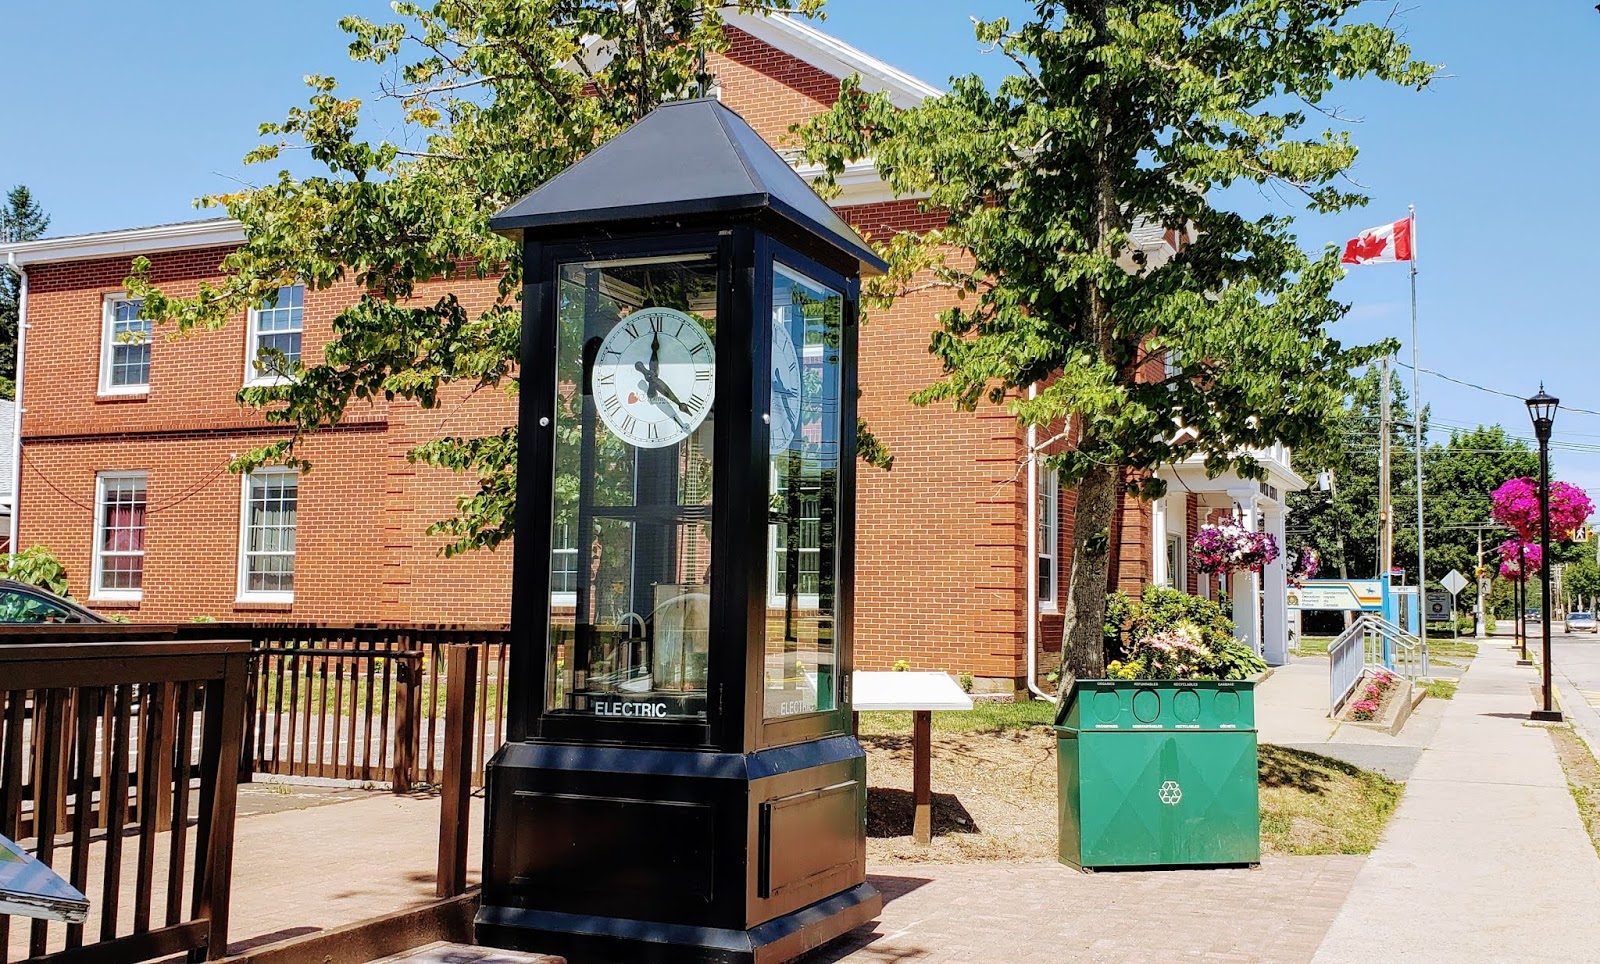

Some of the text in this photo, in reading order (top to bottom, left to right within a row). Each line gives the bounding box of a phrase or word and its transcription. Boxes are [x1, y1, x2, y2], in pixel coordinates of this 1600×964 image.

[648, 316, 663, 333] XII
[689, 342, 705, 356] II
[695, 371, 710, 381] III
[595, 701, 667, 718] ELECTRIC
